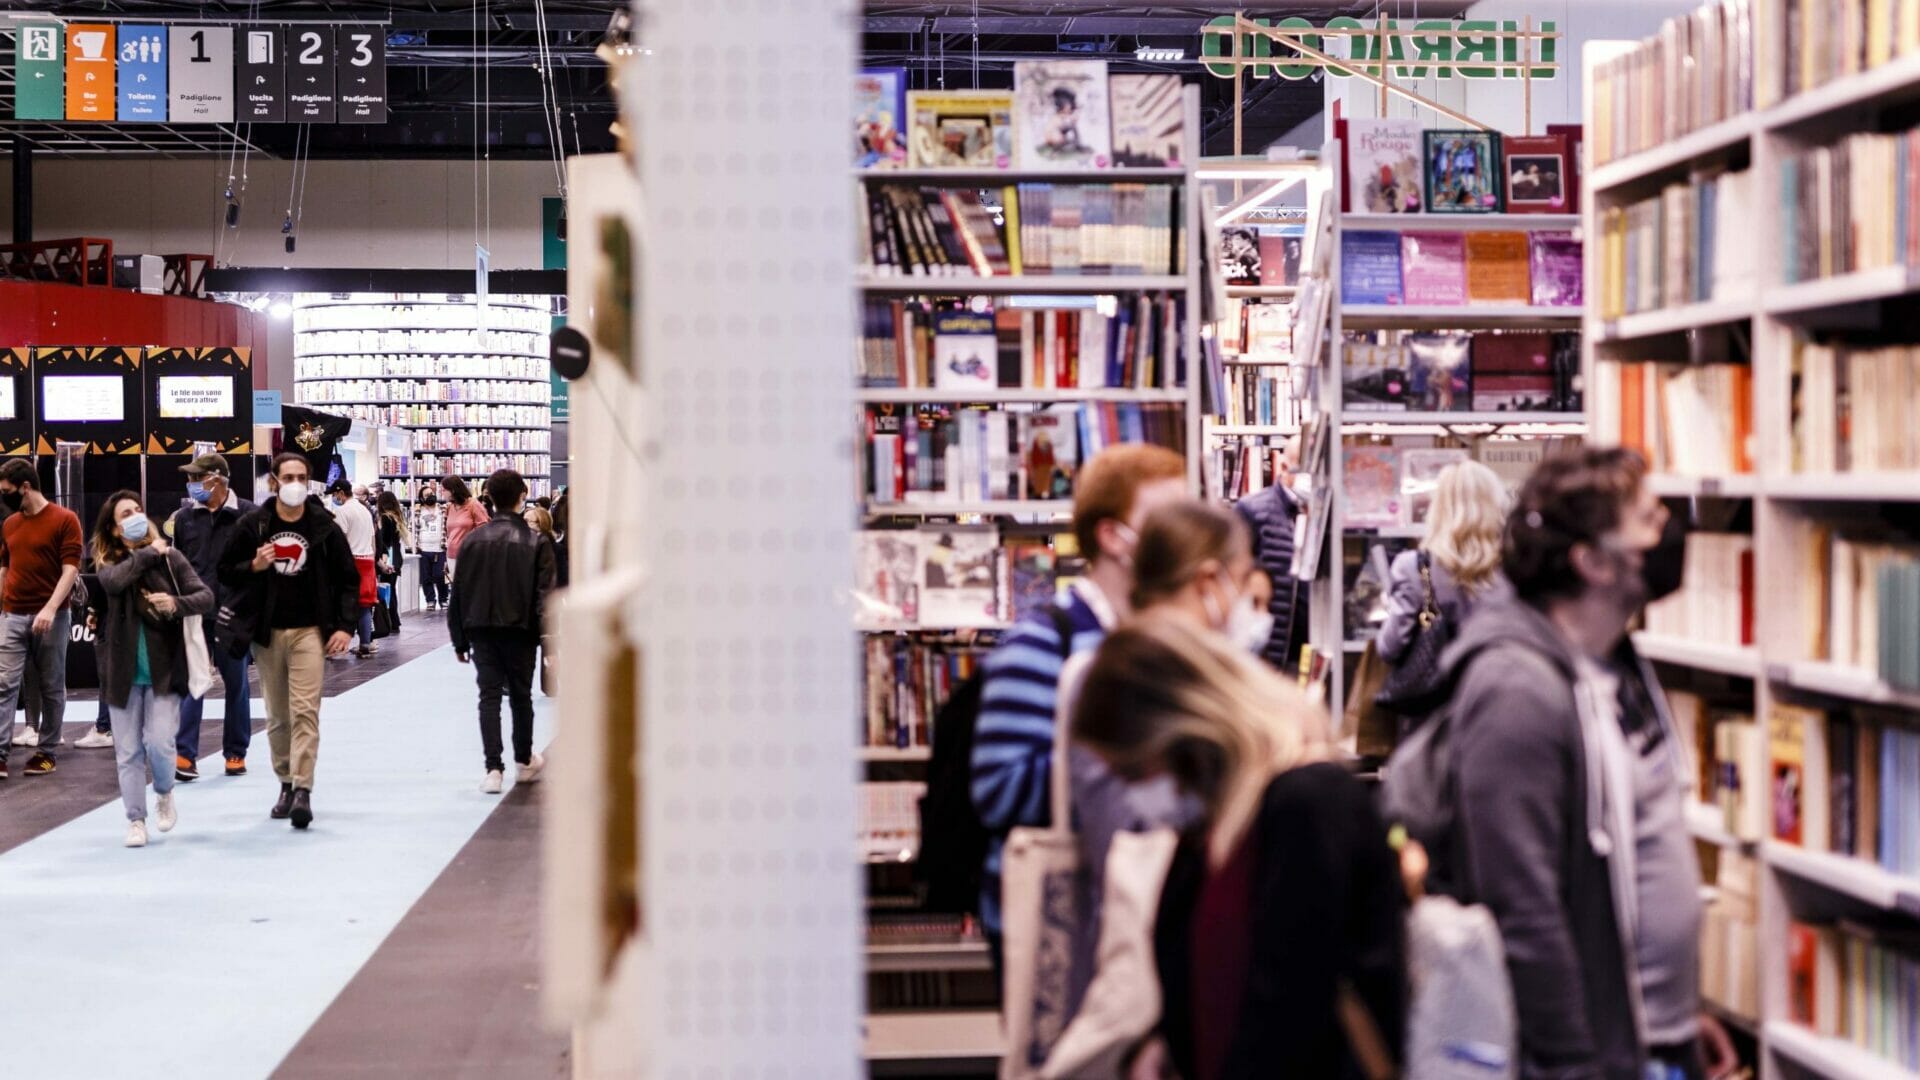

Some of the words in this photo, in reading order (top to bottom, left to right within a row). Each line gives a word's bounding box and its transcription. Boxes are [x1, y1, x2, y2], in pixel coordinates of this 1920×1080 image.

[190, 30, 211, 63] 1
[299, 31, 323, 65] 2
[350, 34, 373, 67] 3
[180, 94, 222, 102] Padiglione
[291, 94, 332, 103] Padiglione
[343, 95, 383, 103] Padiglione
[1361, 133, 1412, 153] Rouge
